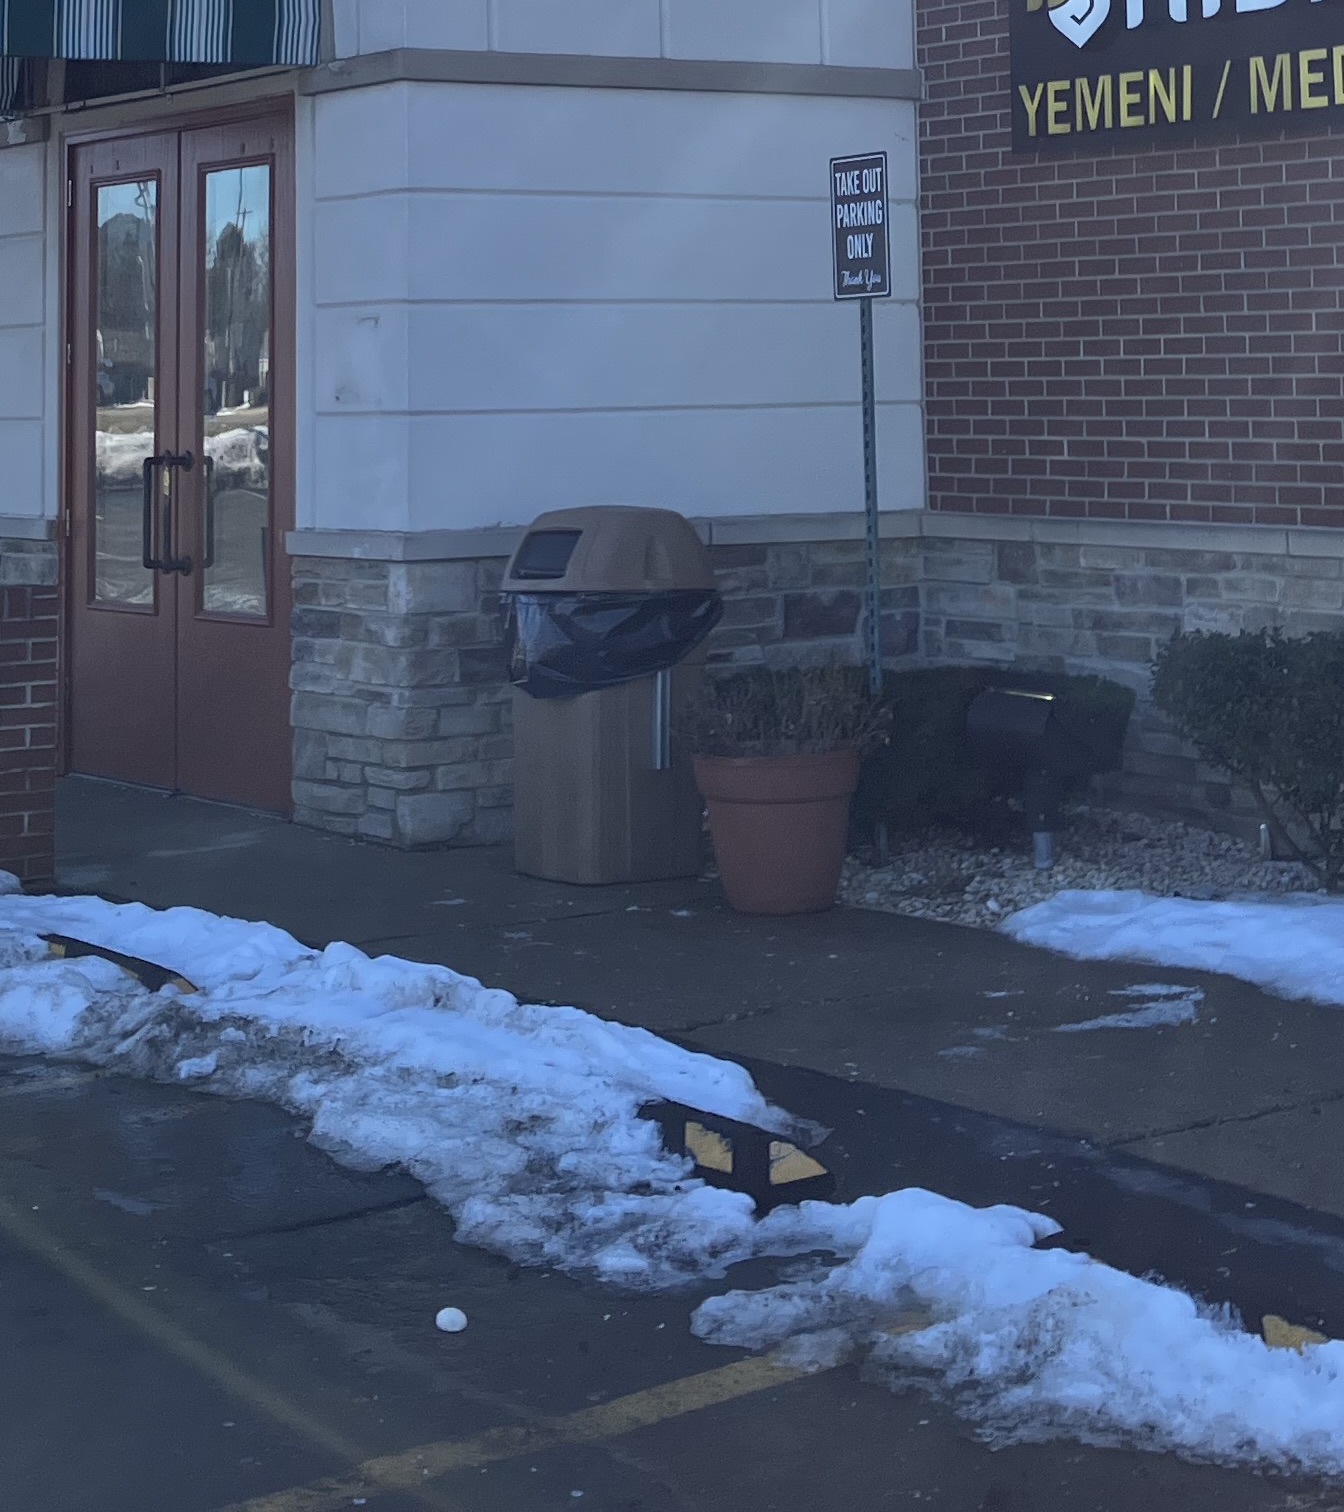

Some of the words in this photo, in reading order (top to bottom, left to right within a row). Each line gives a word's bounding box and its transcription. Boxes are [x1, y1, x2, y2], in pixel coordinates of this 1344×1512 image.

[1018, 65, 1192, 137] YEMENI
[835, 170, 860, 197] TAKE
[862, 167, 882, 194] OUT
[836, 199, 883, 229] PARKING
[846, 232, 874, 260] ONLY
